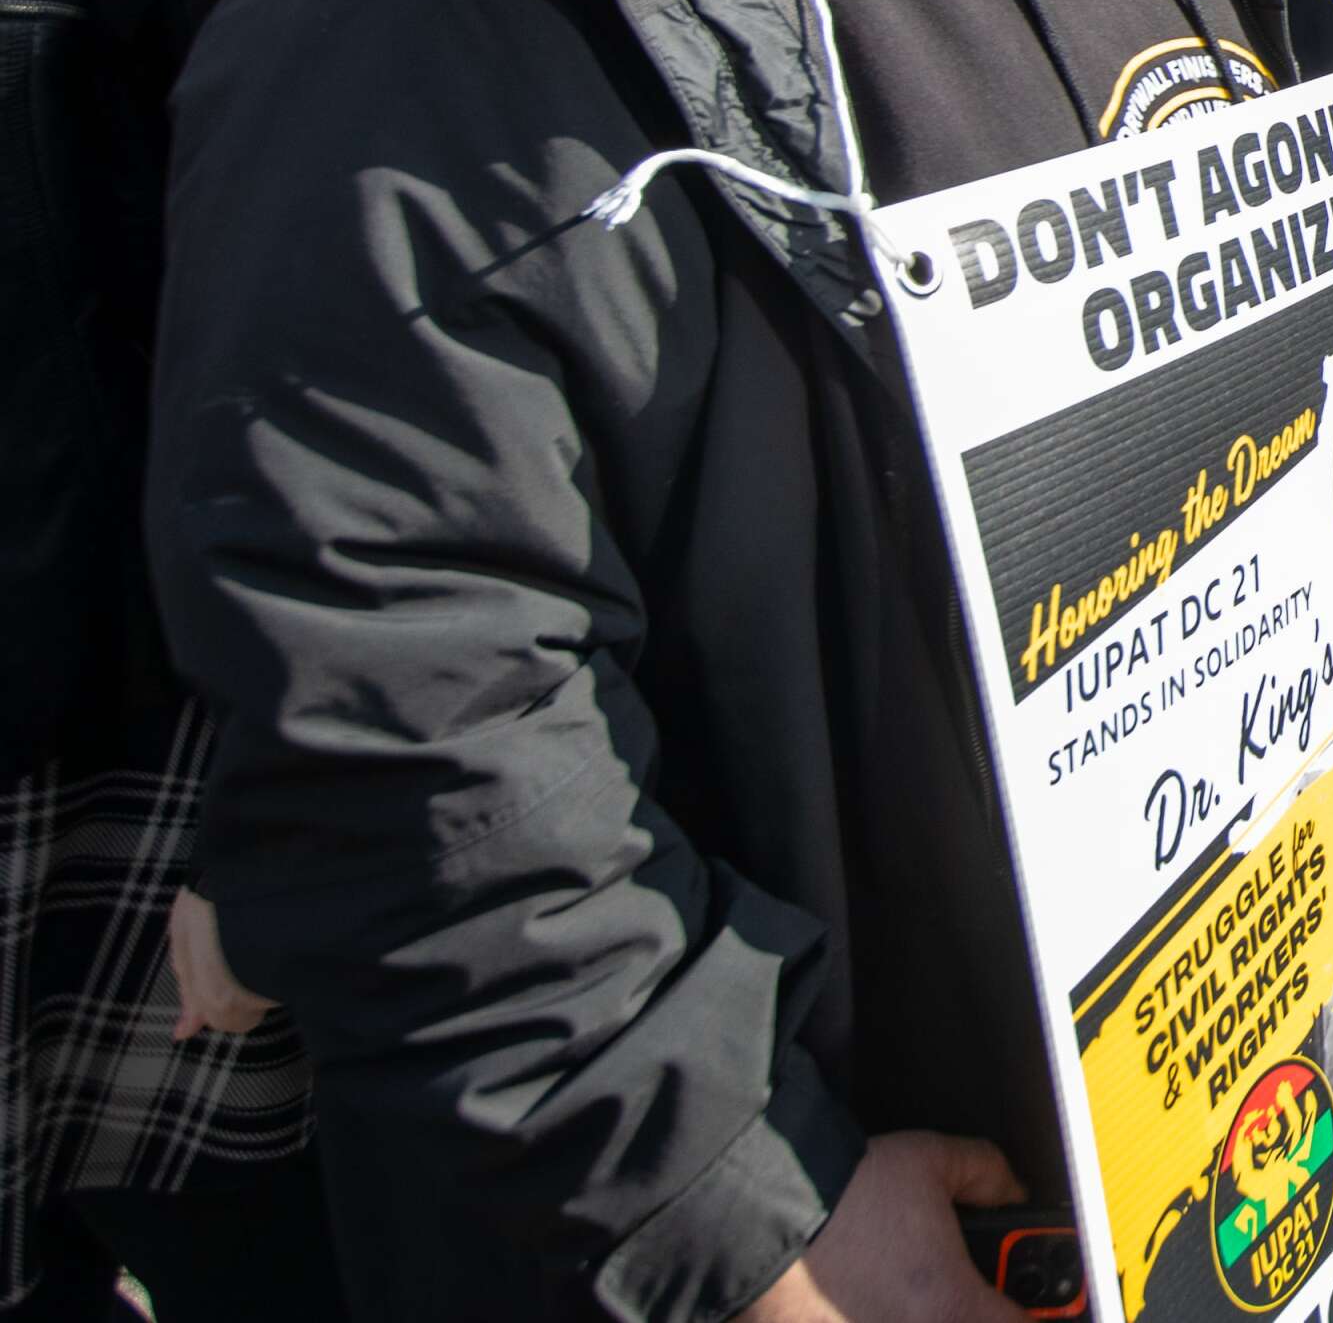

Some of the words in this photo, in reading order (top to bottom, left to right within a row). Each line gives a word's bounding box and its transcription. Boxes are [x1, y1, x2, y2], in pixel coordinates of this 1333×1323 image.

[1166, 55, 1263, 95] FINISERS
[947, 161, 1177, 310] DON'T
[1020, 528, 1179, 682] Honoring
[1181, 469, 1228, 545] the
[1227, 407, 1316, 507] Dream
[1049, 691, 1152, 786] STANDS
[1161, 668, 1186, 712] IN
[1194, 581, 1313, 688] SOLIDARITY
[1066, 611, 1169, 713] IUPAT
[1181, 577, 1221, 640] DC
[1232, 554, 1260, 607] 21
[1144, 768, 1221, 871] Dr.
[1135, 842, 1286, 1035] STRUGGLE
[1292, 819, 1315, 881] for
[1147, 970, 1227, 1074] CIVIL
[1230, 843, 1326, 979] RIGHTS
[1163, 1063, 1182, 1110] &
[1184, 886, 1327, 1083] WORKERS'
[1207, 962, 1309, 1109] RIGHTS
[1250, 1181, 1321, 1288] IUPAT
[1268, 1261, 1295, 1299] DC
[1295, 1229, 1316, 1277] 21
